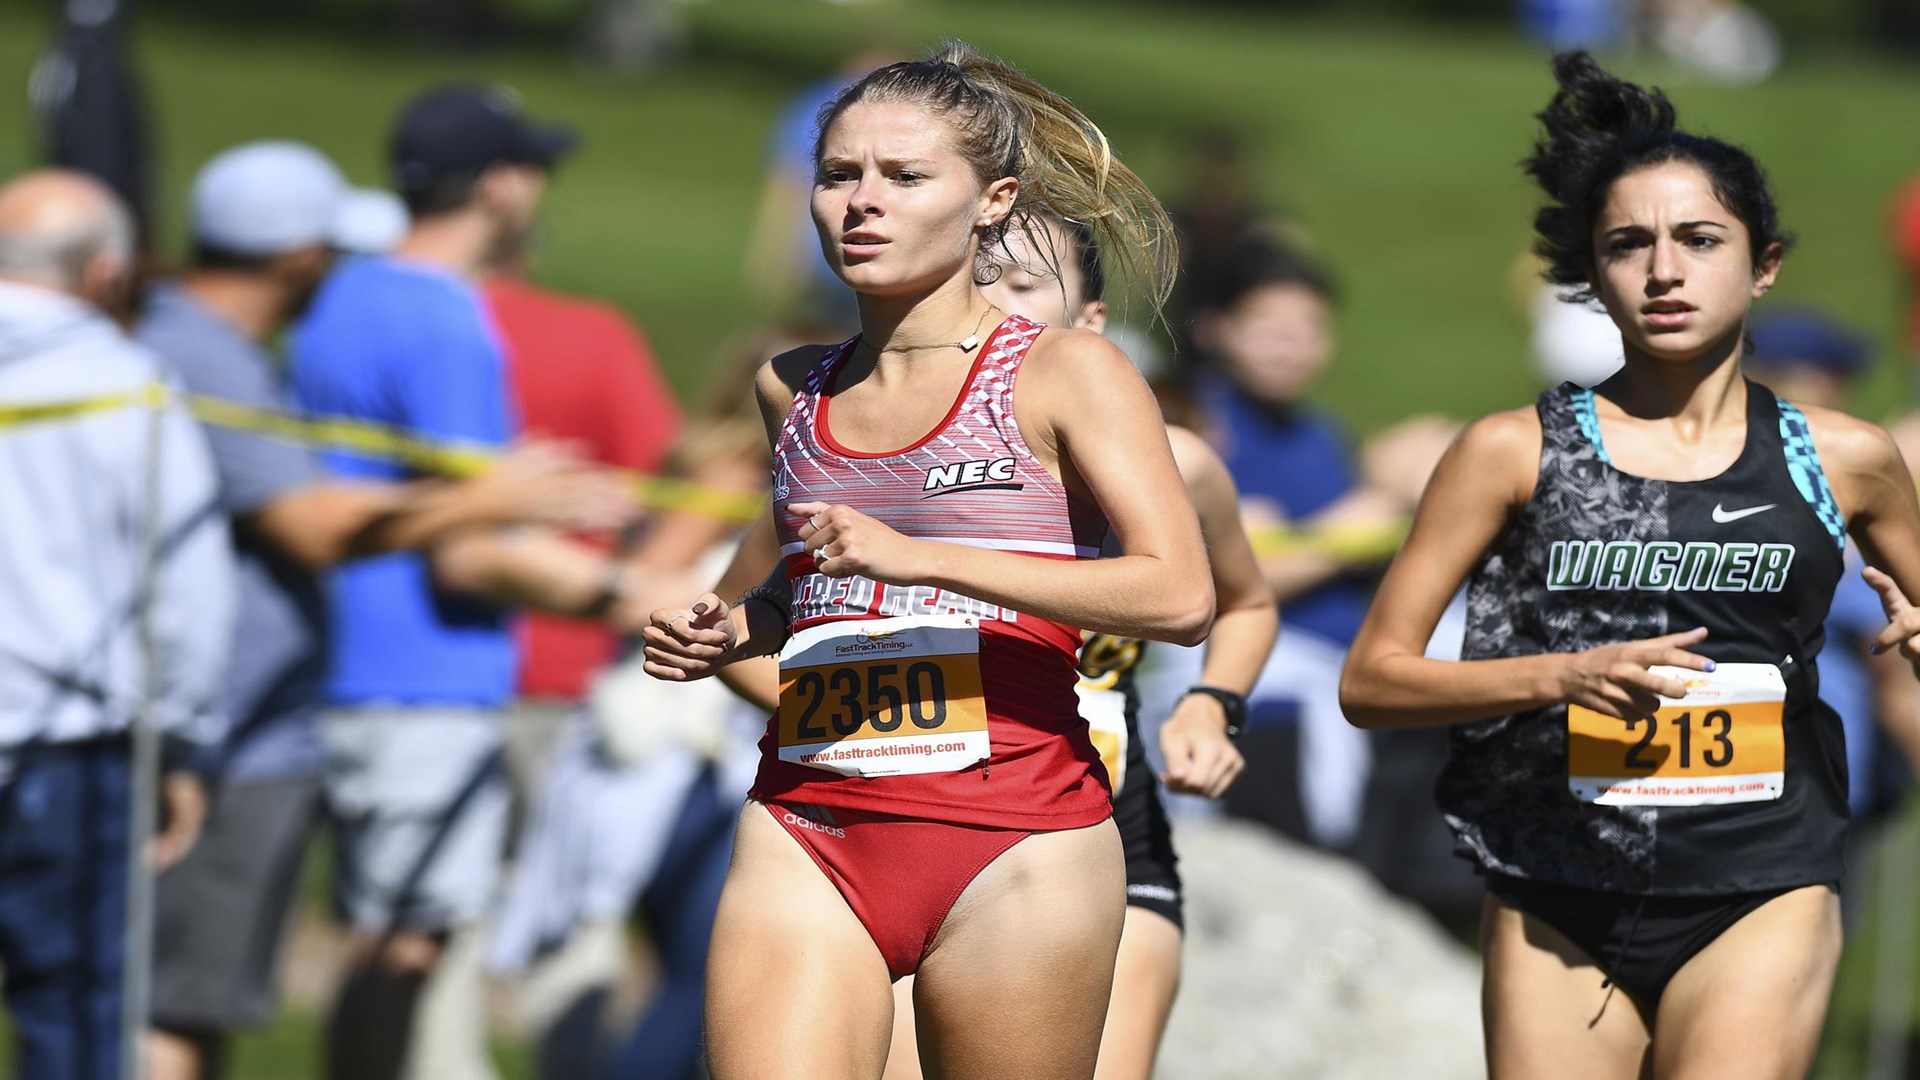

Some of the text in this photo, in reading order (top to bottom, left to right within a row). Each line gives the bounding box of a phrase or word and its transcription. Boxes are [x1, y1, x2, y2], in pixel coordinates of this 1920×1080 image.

[922, 458, 1017, 491] NEC
[1547, 541, 1795, 592] WAGNER
[835, 641, 906, 653] FastTrackTiming
[797, 661, 947, 739] 2350
[800, 742, 966, 763] www.fasttracktiming.com
[1625, 709, 1733, 768] 213
[784, 813, 846, 838] adidas
